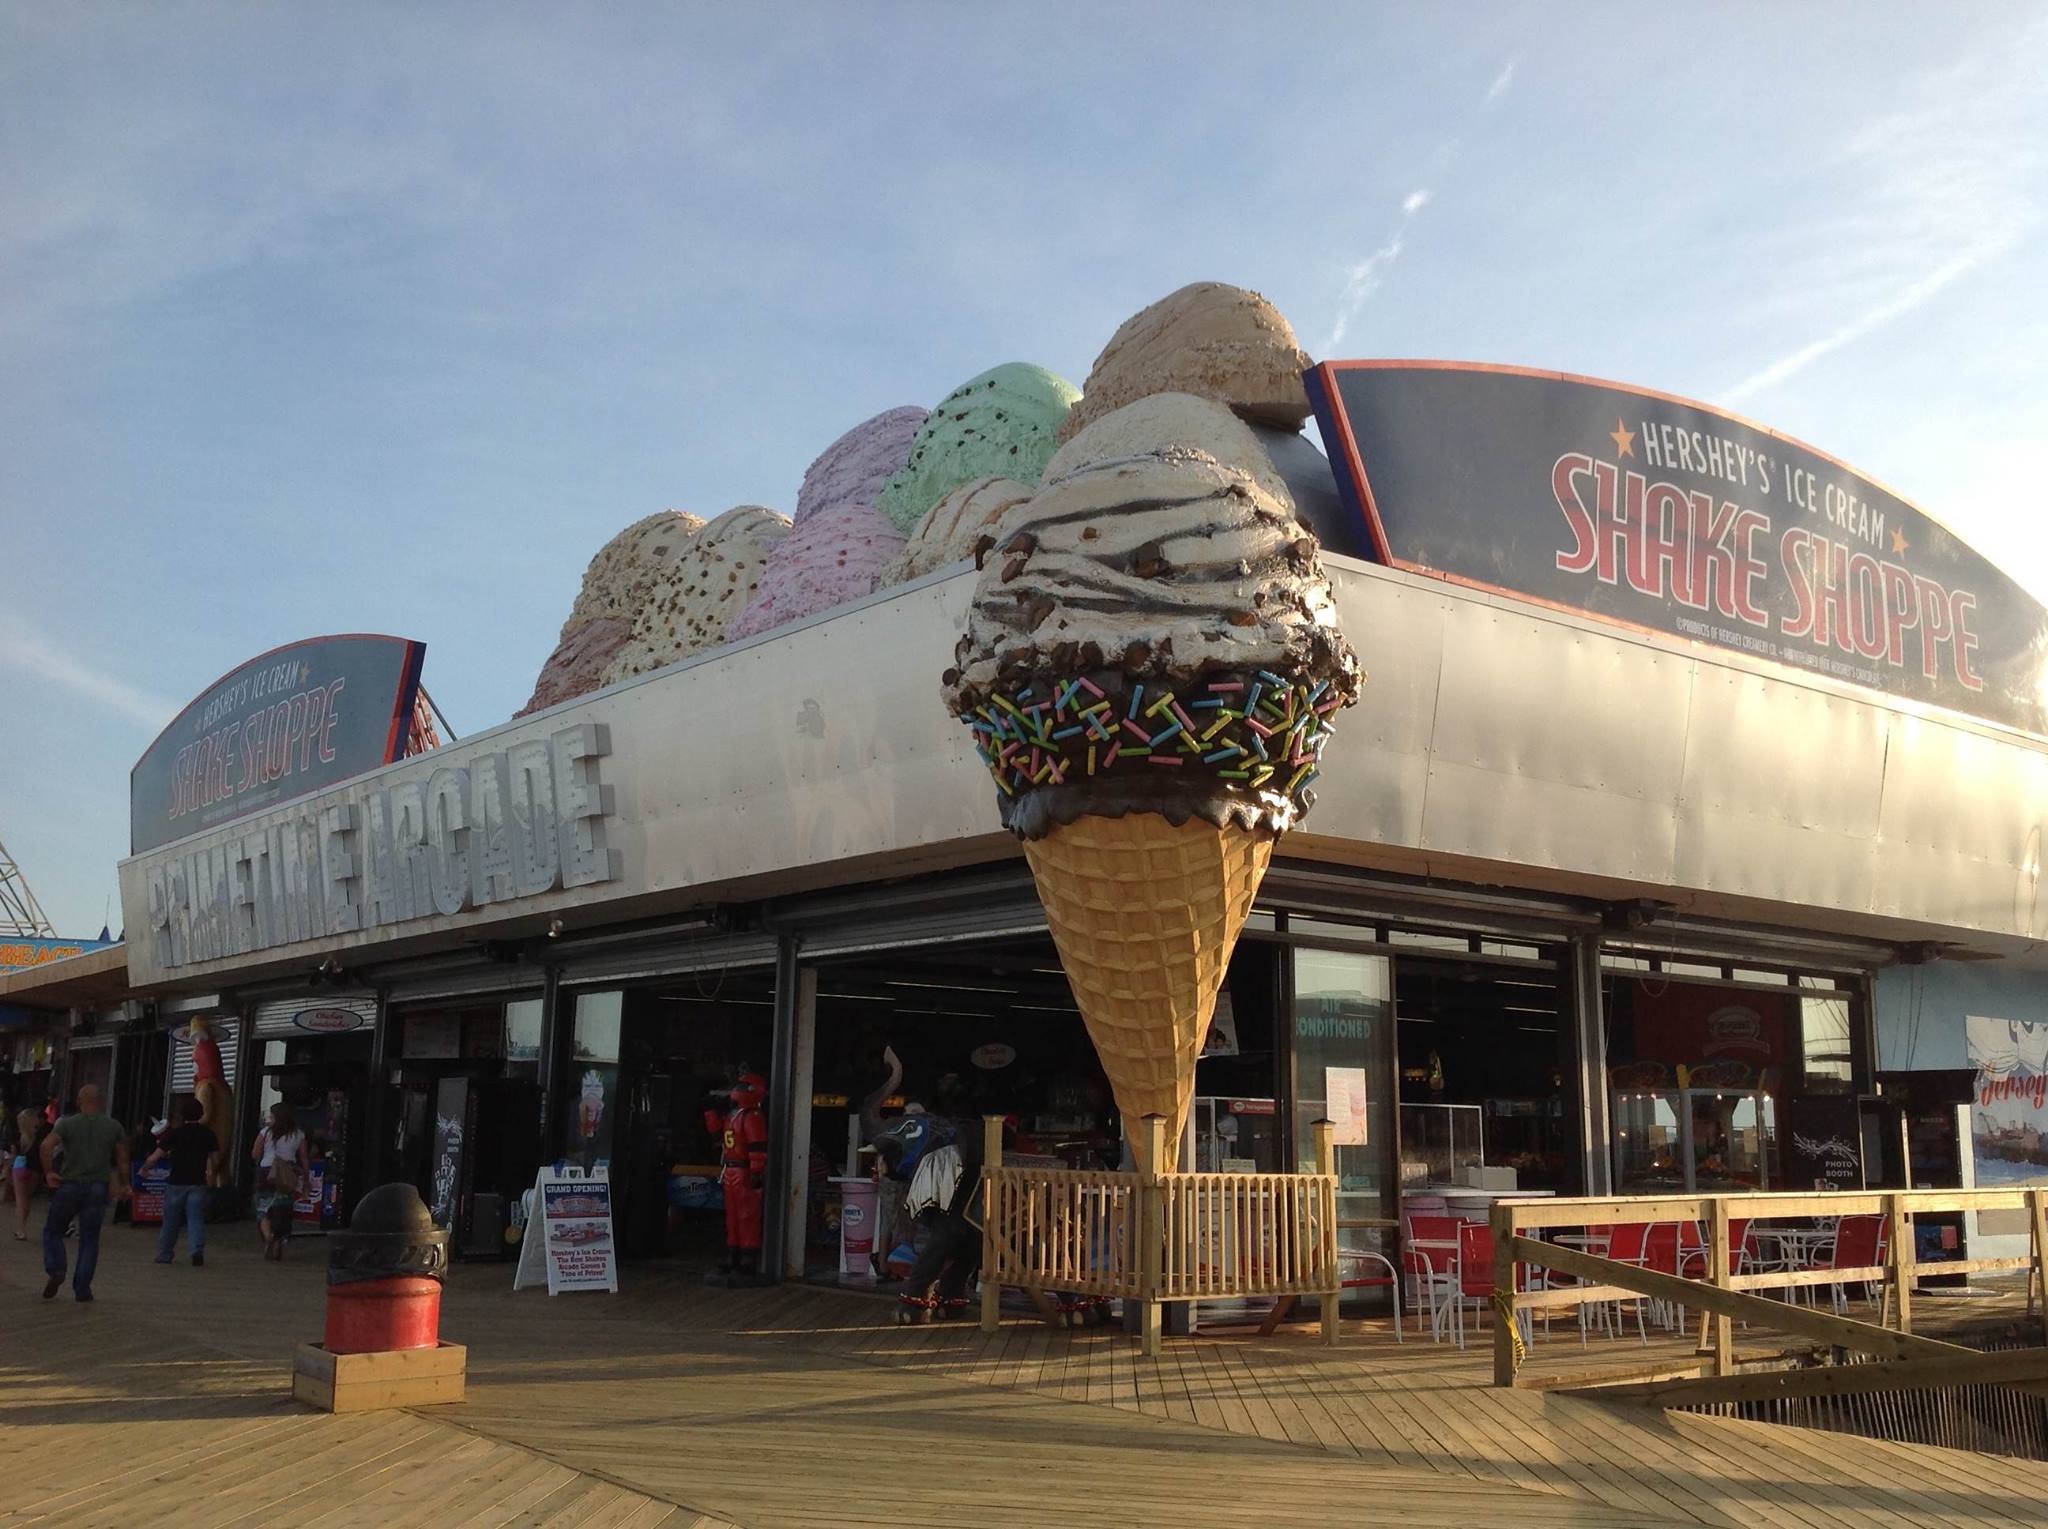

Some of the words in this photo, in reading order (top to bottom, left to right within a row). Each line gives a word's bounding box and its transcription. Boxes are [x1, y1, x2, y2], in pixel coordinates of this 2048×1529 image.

[1641, 421, 1771, 494] HERSHEY'S
[1784, 464, 1818, 513] ICE
[1825, 485, 1885, 551] CREAM
[1552, 452, 1771, 629] SHAKE
[1779, 527, 1983, 692] SHOPPE
[169, 721, 241, 820] SHAKE
[238, 677, 345, 793] SHOPPE
[202, 679, 249, 731] HERSHEY'S
[251, 670, 268, 701] ICE
[268, 661, 300, 695] CREAM
[358, 723, 613, 928] ARCADE
[546, 1185, 571, 1193] GRAND
